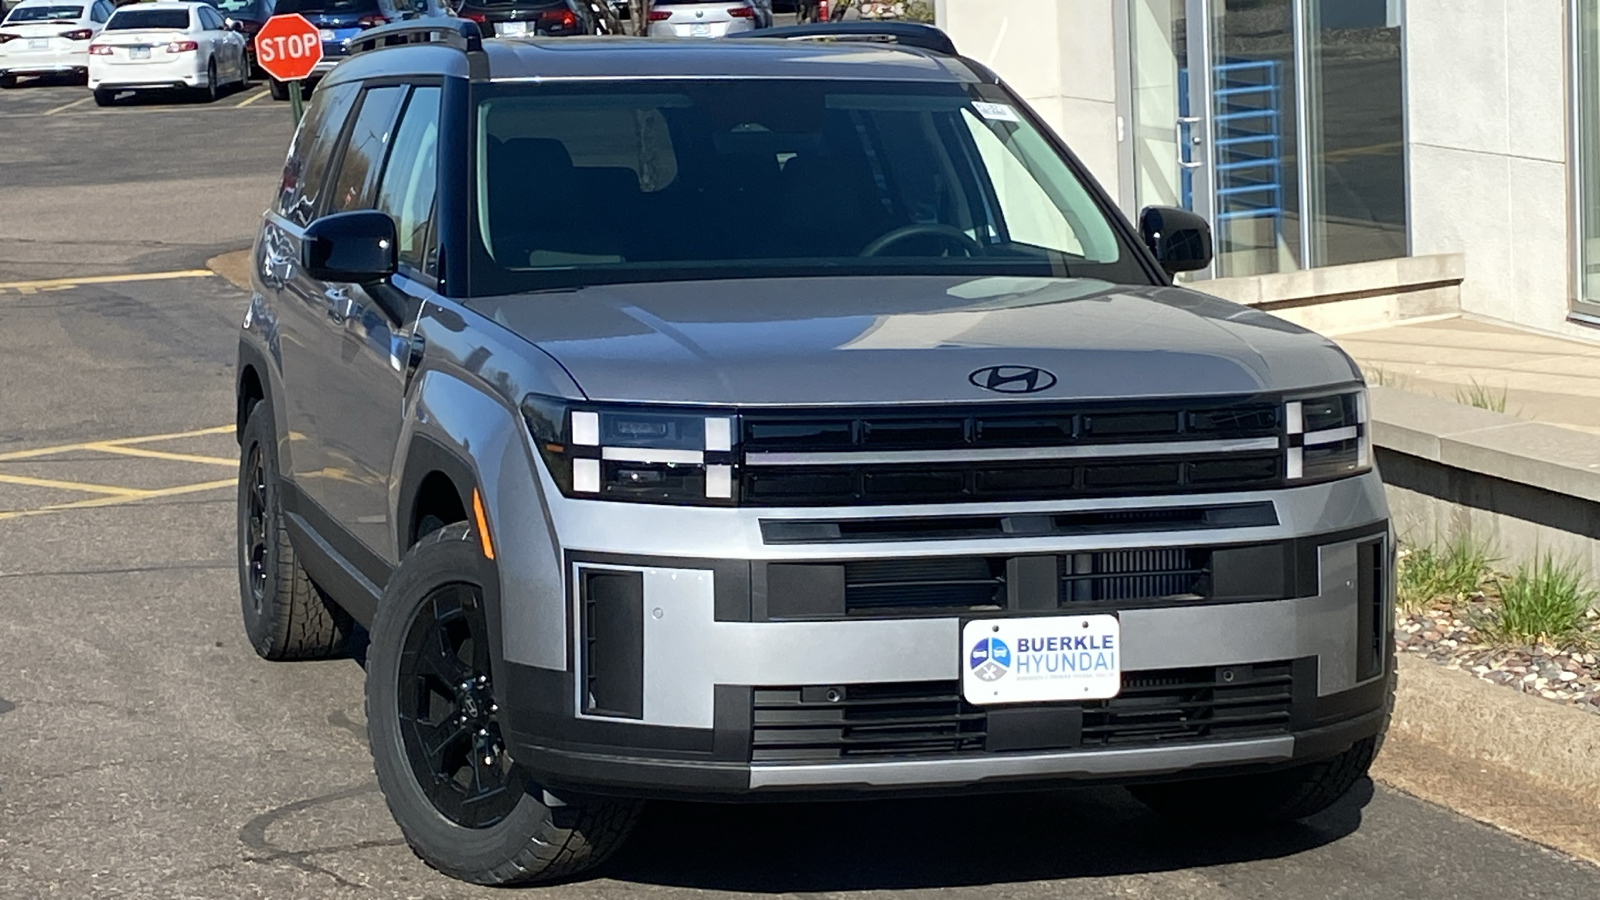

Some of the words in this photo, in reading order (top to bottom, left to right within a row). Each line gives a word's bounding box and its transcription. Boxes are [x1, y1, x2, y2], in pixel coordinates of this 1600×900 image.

[261, 33, 317, 62] STOP
[1017, 635, 1113, 653] BUERKLE
[1017, 652, 1114, 674] HYUNDAI
